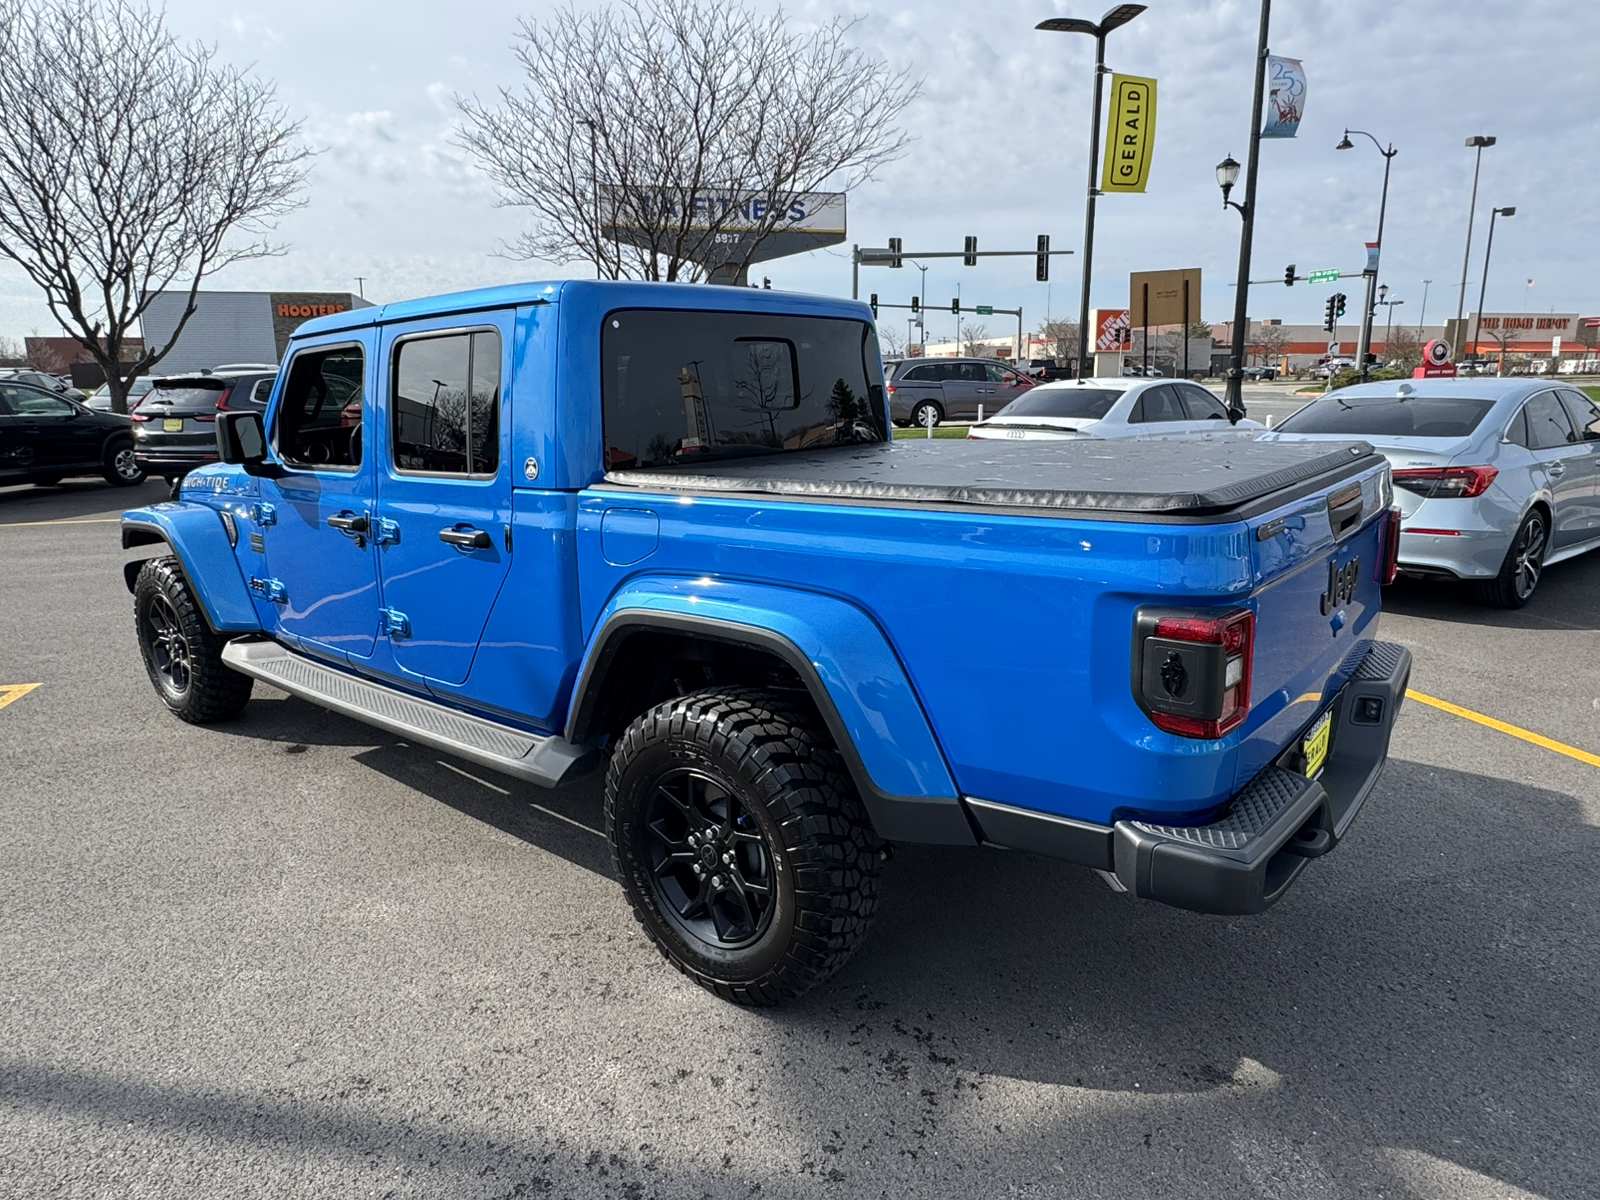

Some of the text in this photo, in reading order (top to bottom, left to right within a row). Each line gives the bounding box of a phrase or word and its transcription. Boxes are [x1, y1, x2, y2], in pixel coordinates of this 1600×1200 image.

[1120, 90, 1141, 176] GERALD
[692, 197, 805, 222] FITNESS
[714, 233, 740, 244] 5917
[277, 303, 344, 317] HOOTERS
[1480, 317, 1571, 330] THE HOME DEPOT
[206, 476, 230, 489] TIDE
[1320, 555, 1359, 616] Jeep
